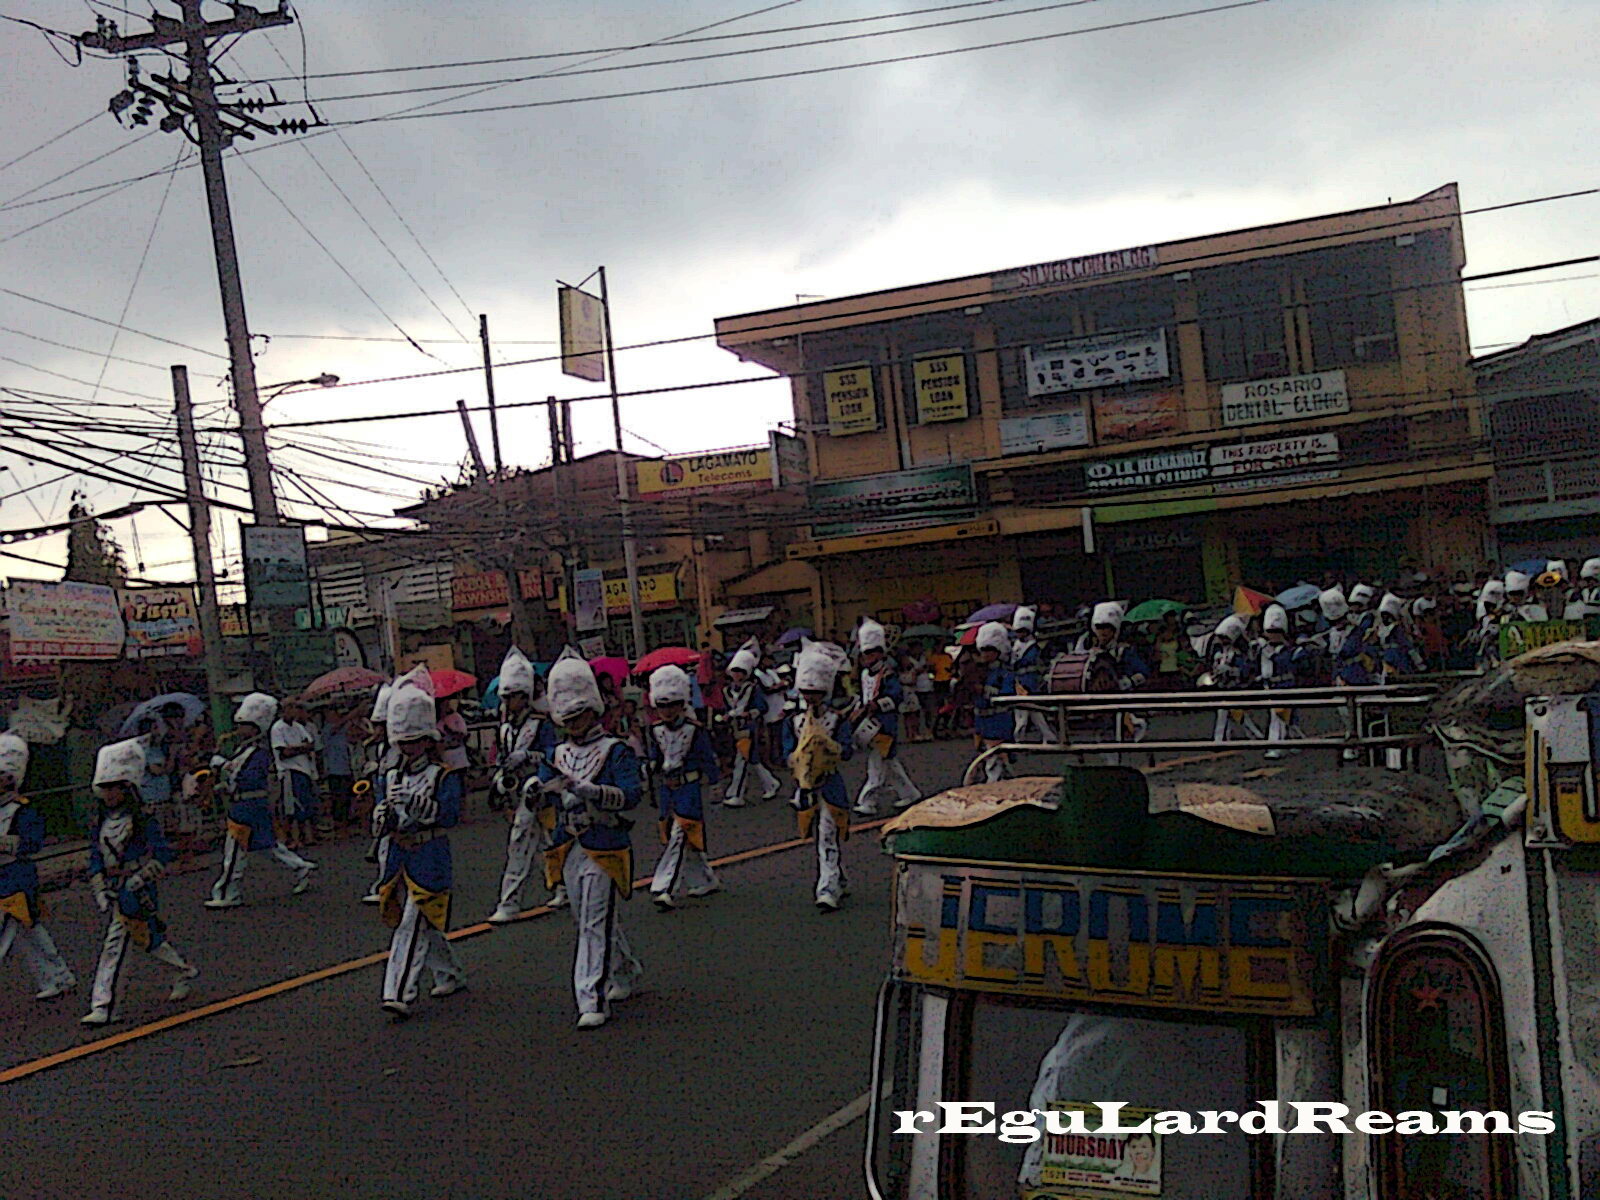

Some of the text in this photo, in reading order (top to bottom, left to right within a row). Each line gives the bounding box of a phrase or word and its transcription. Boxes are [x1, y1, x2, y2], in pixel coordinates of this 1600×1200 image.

[929, 361, 948, 374] SSS
[838, 373, 858, 387] SSS
[1243, 377, 1323, 400] ROSARIO
[1226, 391, 1345, 423] DENTAL CLINIC
[1222, 447, 1244, 459] THIS
[1249, 439, 1307, 456] PROPERTY
[688, 450, 759, 472] LAGAMAYO
[1137, 451, 1207, 474] HERNANDEZ
[697, 468, 753, 483] Telecoms
[905, 875, 1296, 1000] JEROME
[1046, 1133, 1128, 1160] THURSDAY
